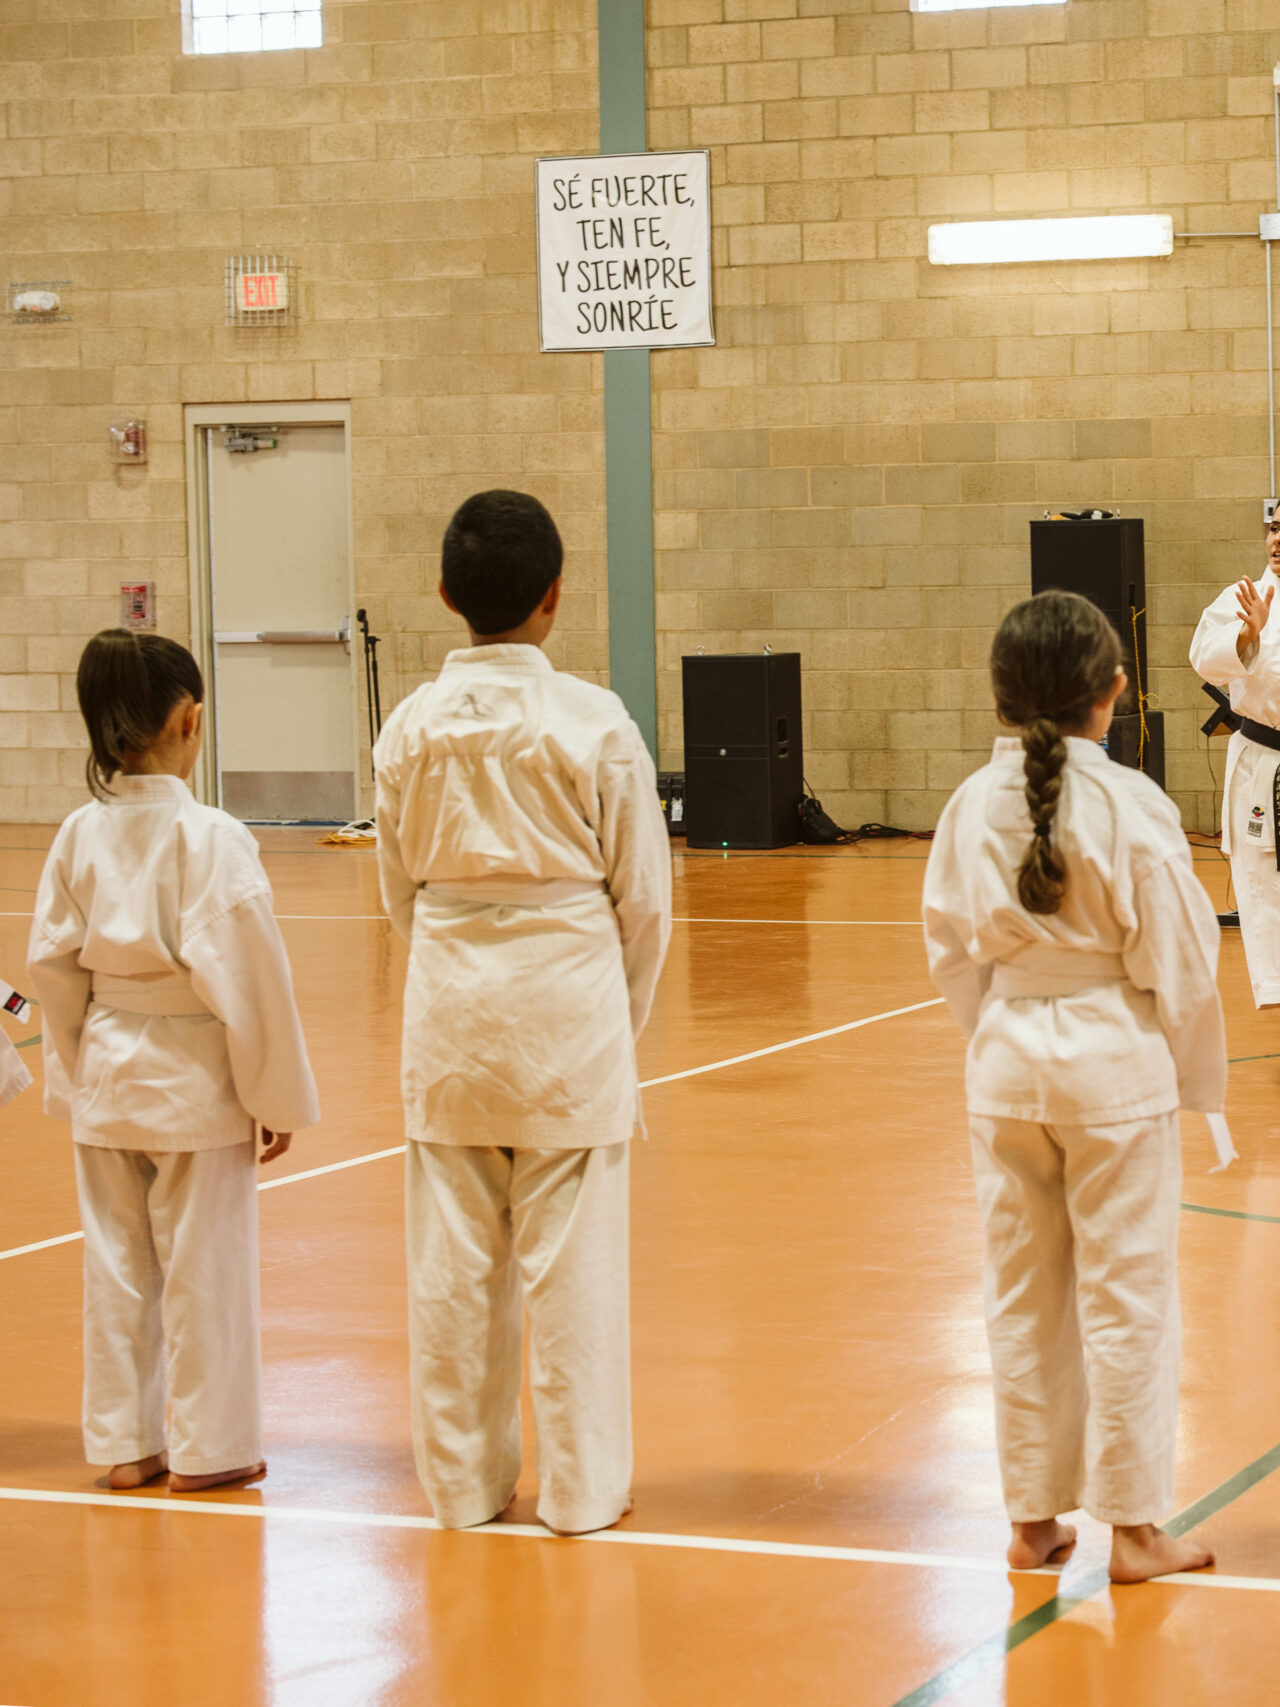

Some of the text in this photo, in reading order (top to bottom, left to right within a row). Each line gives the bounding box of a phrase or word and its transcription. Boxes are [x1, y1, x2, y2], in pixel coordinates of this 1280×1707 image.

[553, 173, 695, 212] SÉ FUERTE,
[576, 216, 670, 251] TEN FE,
[243, 275, 279, 307] EXIT
[556, 257, 697, 293] Y SIEMPRE
[576, 294, 679, 335] SONRÍE
